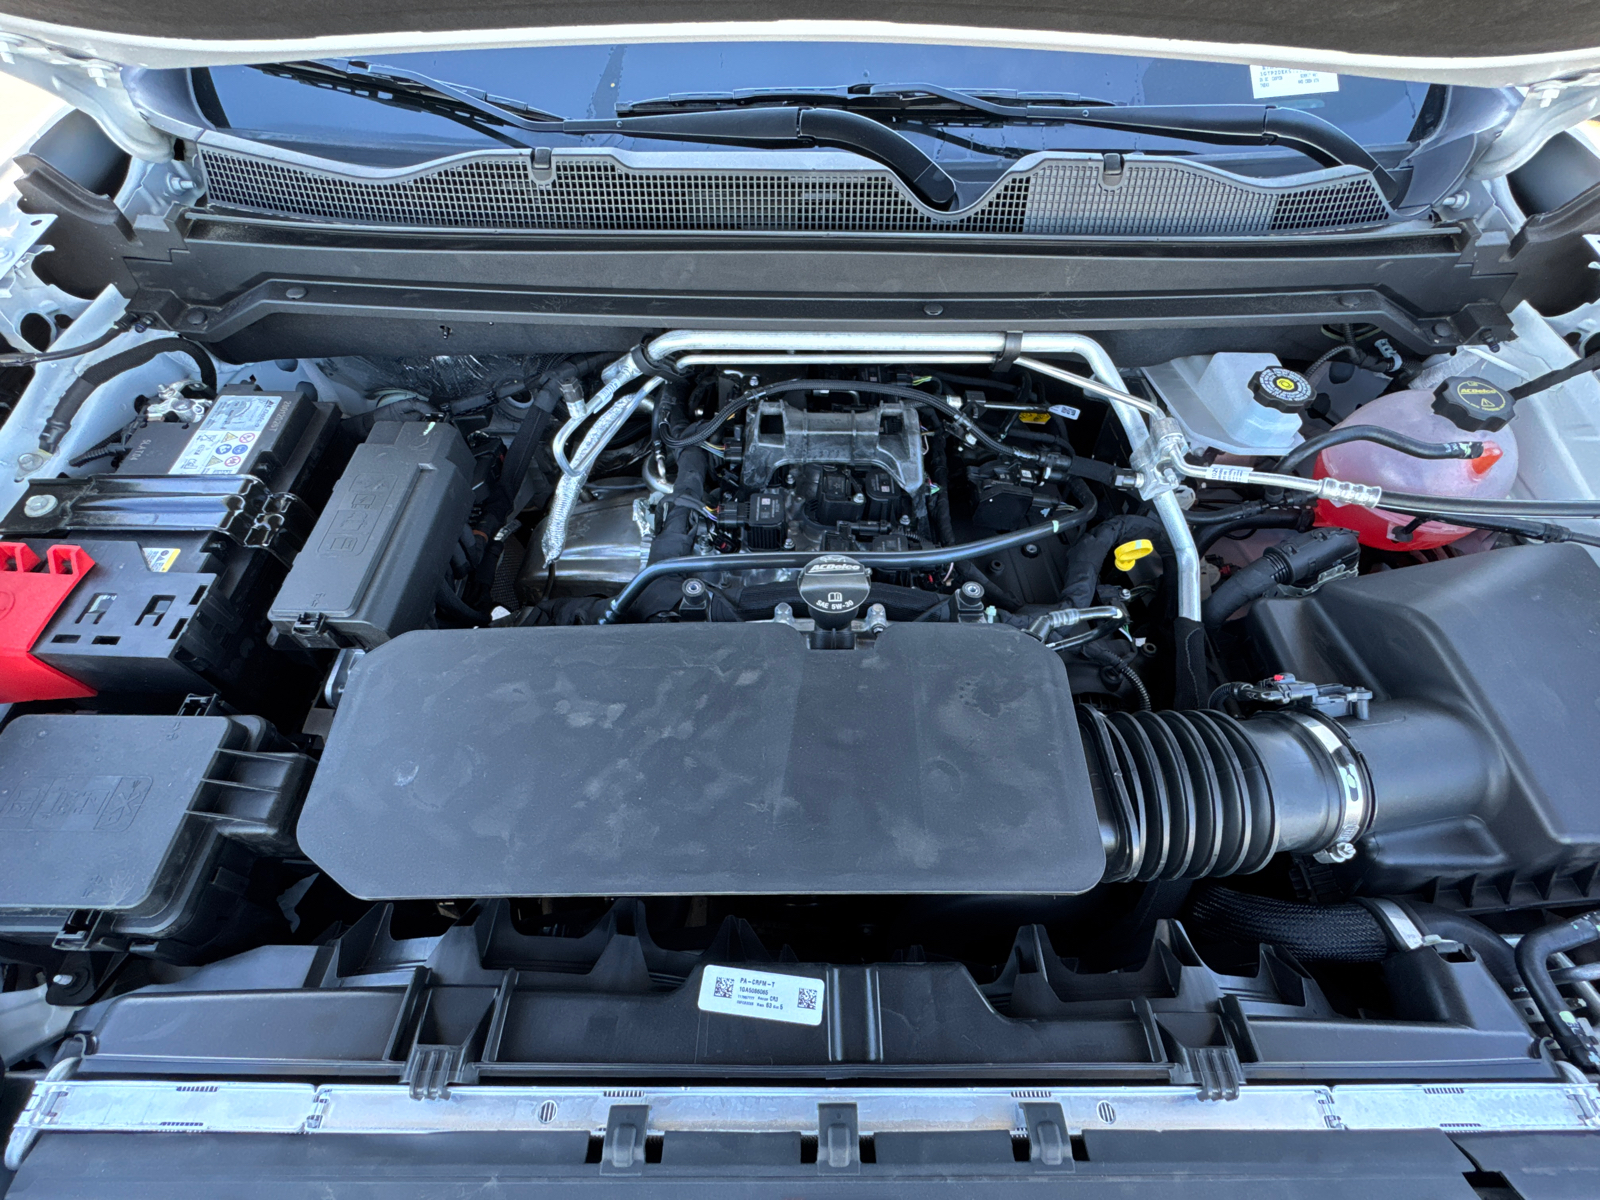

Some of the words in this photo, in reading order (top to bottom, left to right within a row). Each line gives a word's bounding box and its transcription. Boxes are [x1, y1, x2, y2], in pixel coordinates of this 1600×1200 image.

[808, 563, 861, 573] ACDelco
[816, 600, 830, 610] SAE
[831, 600, 854, 610] 5W-30
